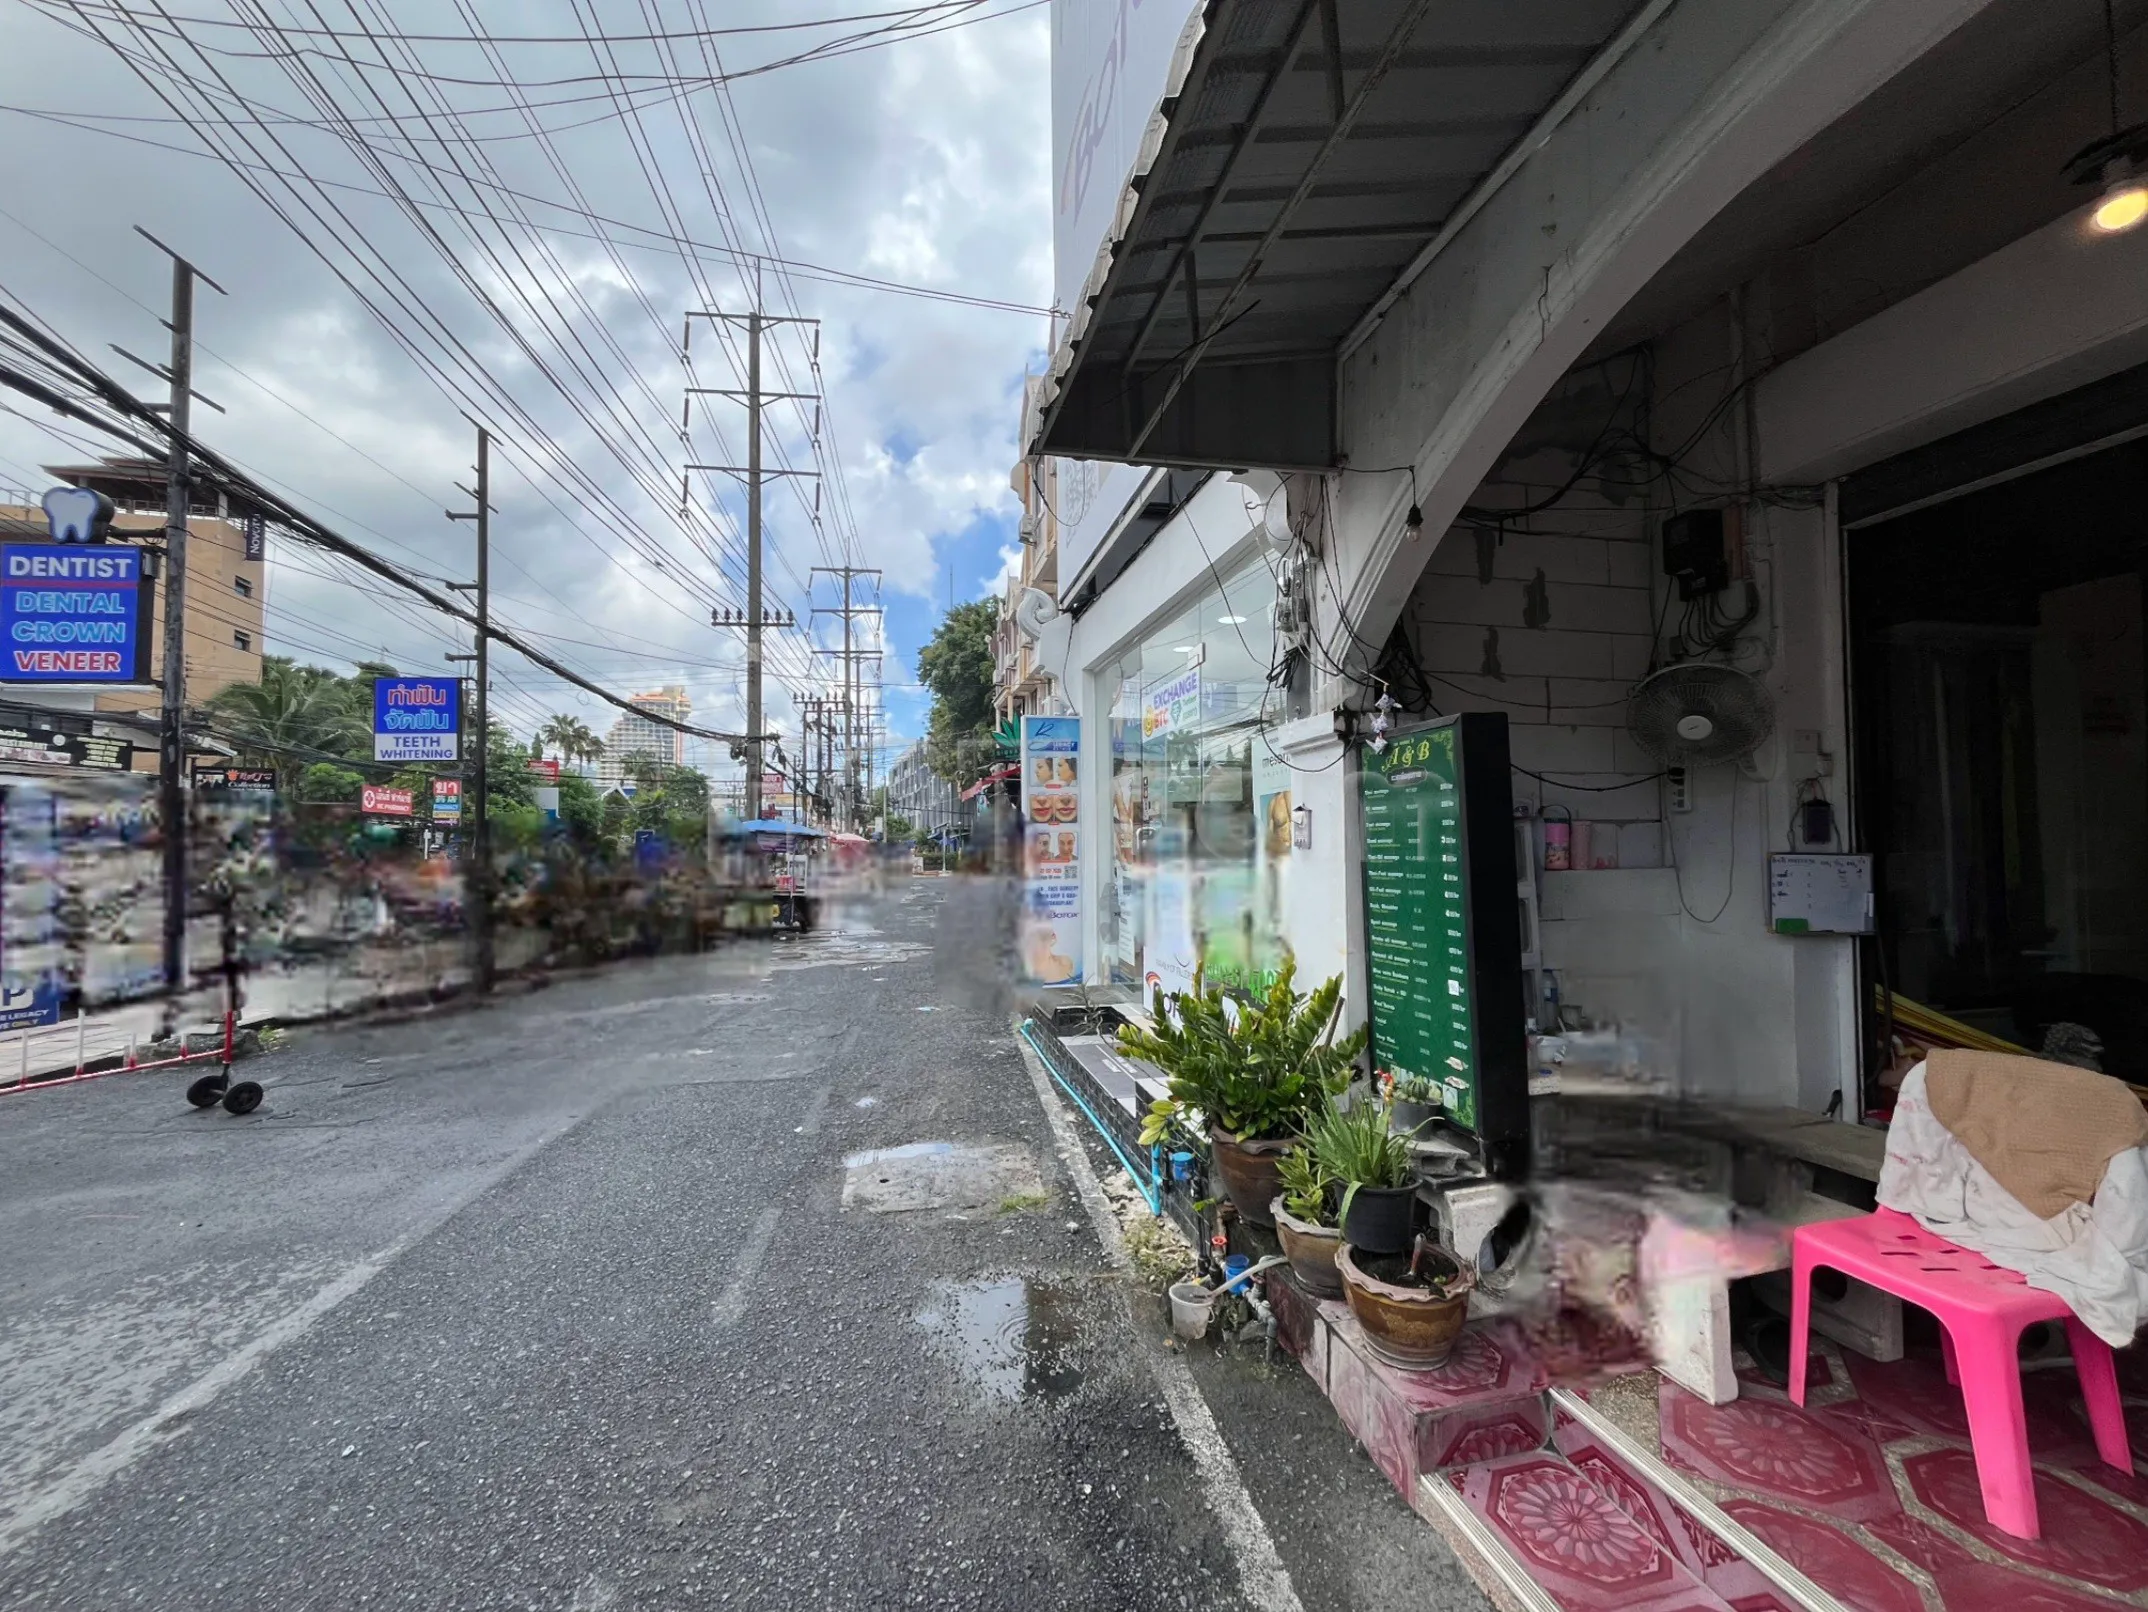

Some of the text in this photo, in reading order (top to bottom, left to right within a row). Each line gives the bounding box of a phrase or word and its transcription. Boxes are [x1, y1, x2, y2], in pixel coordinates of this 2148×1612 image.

[9, 556, 132, 578] DENTIST
[15, 591, 125, 614] DENTAL
[11, 620, 126, 643] CROWN
[13, 650, 121, 672] VENEER
[388, 684, 446, 705] ทำฟัน
[1153, 672, 1197, 709] EXCHANGE
[383, 708, 448, 729] จัดฟัน
[393, 736, 440, 747] TEETH
[380, 749, 453, 759] WHITENING
[1381, 746, 1400, 772] A
[1417, 739, 1430, 761] B
[435, 781, 458, 794] ยา
